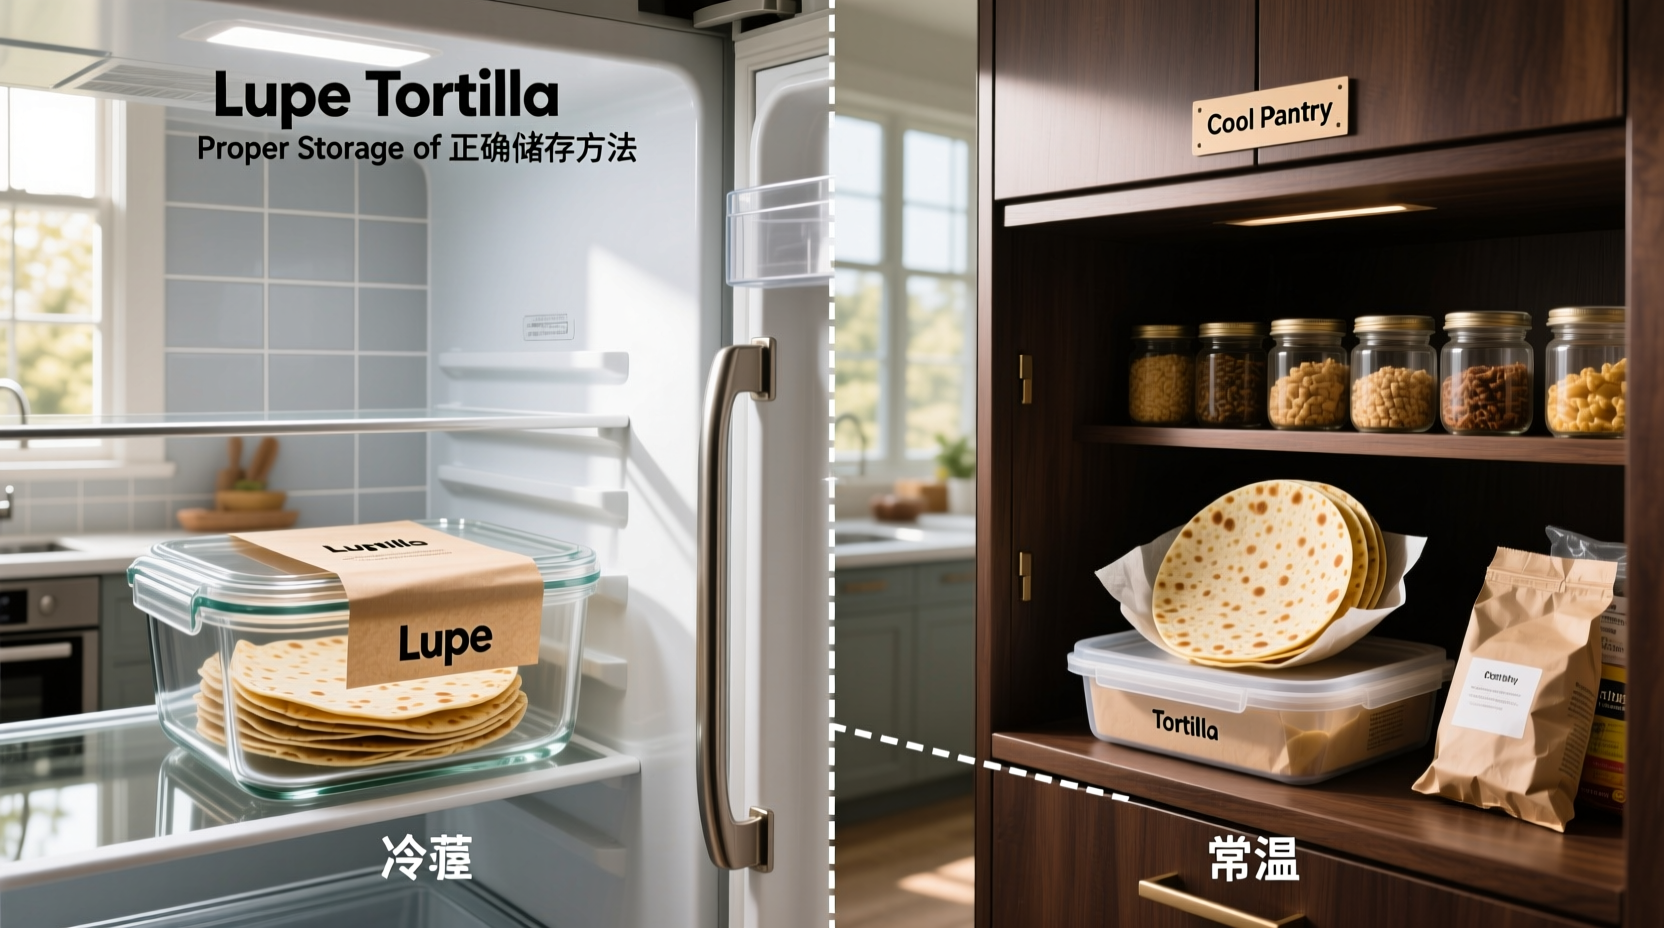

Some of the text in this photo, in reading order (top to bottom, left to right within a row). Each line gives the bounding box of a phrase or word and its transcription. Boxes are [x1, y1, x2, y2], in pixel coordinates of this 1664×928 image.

[1207, 101, 1334, 135] Cool Pantry
[399, 624, 493, 667] Lupe
[1152, 708, 1219, 741] Tortilla
